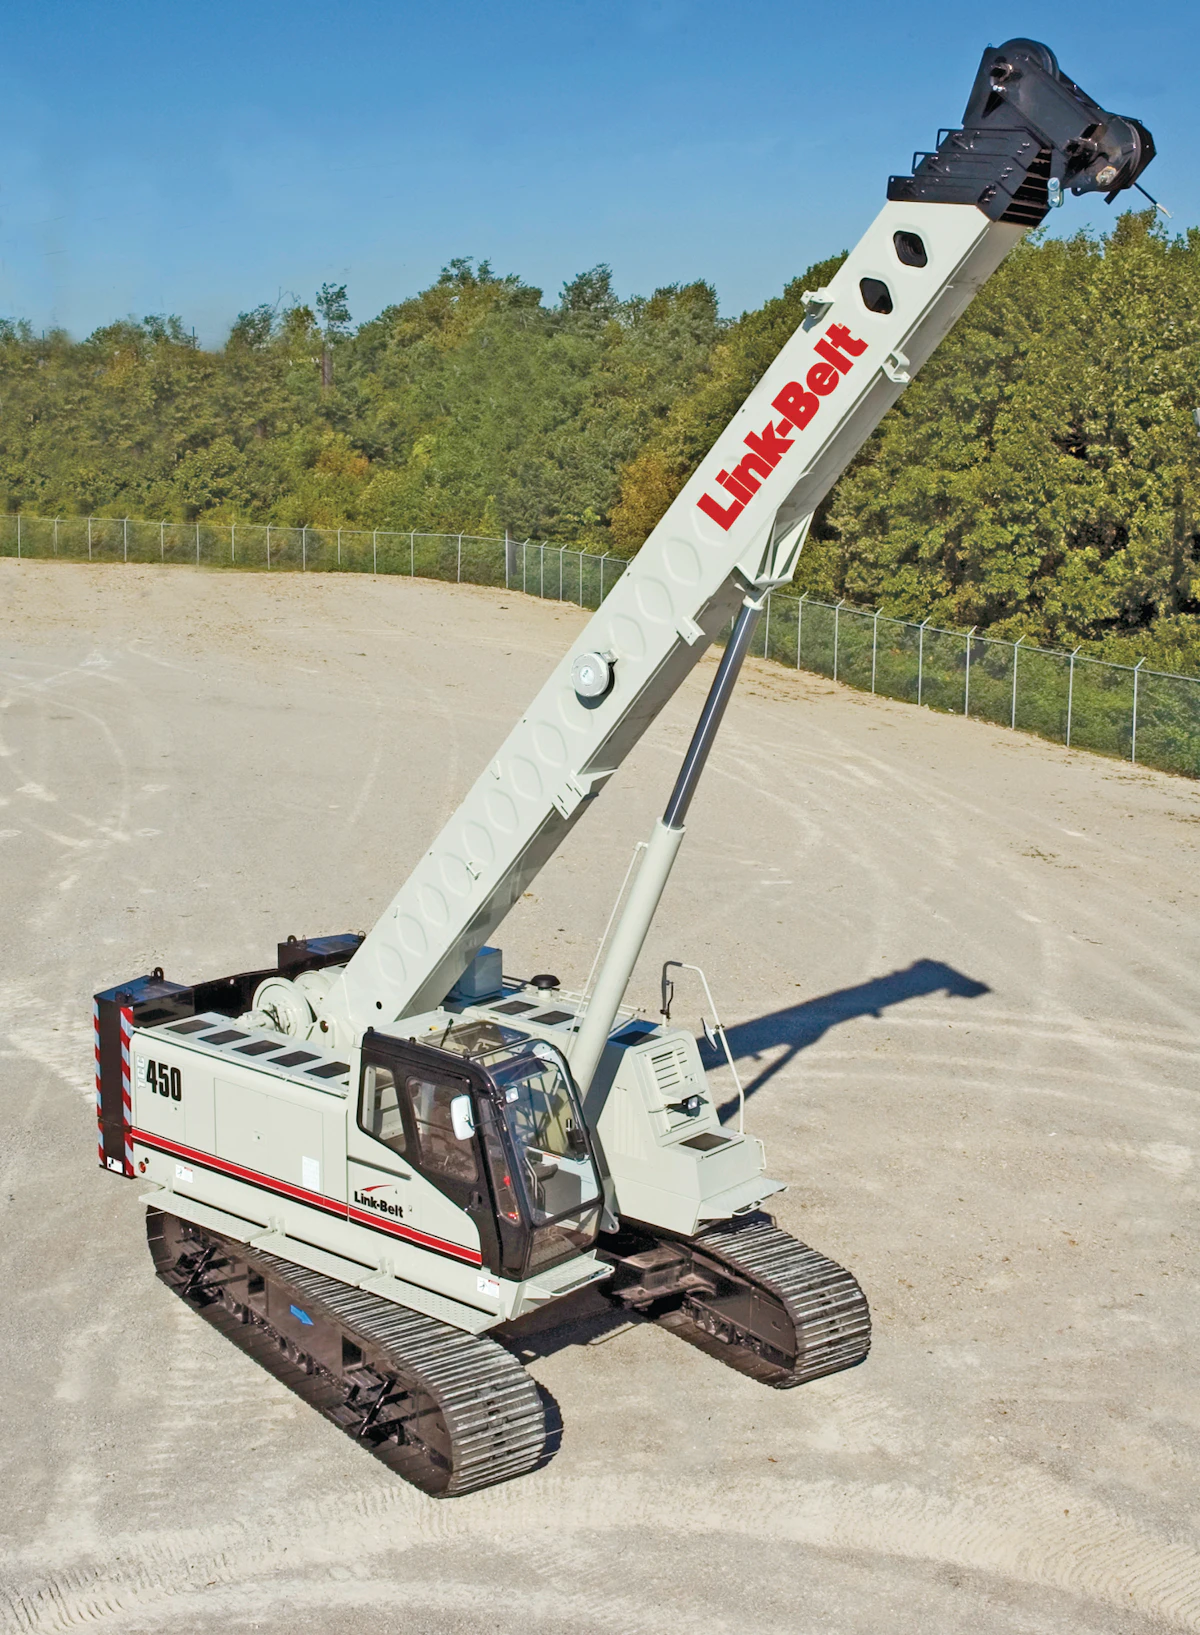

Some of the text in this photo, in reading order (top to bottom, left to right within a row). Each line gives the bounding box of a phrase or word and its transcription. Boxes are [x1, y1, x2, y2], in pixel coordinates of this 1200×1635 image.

[697, 323, 869, 532] Link-Belt
[146, 1059, 182, 1102] 450
[354, 1191, 404, 1218] Link-Belt
